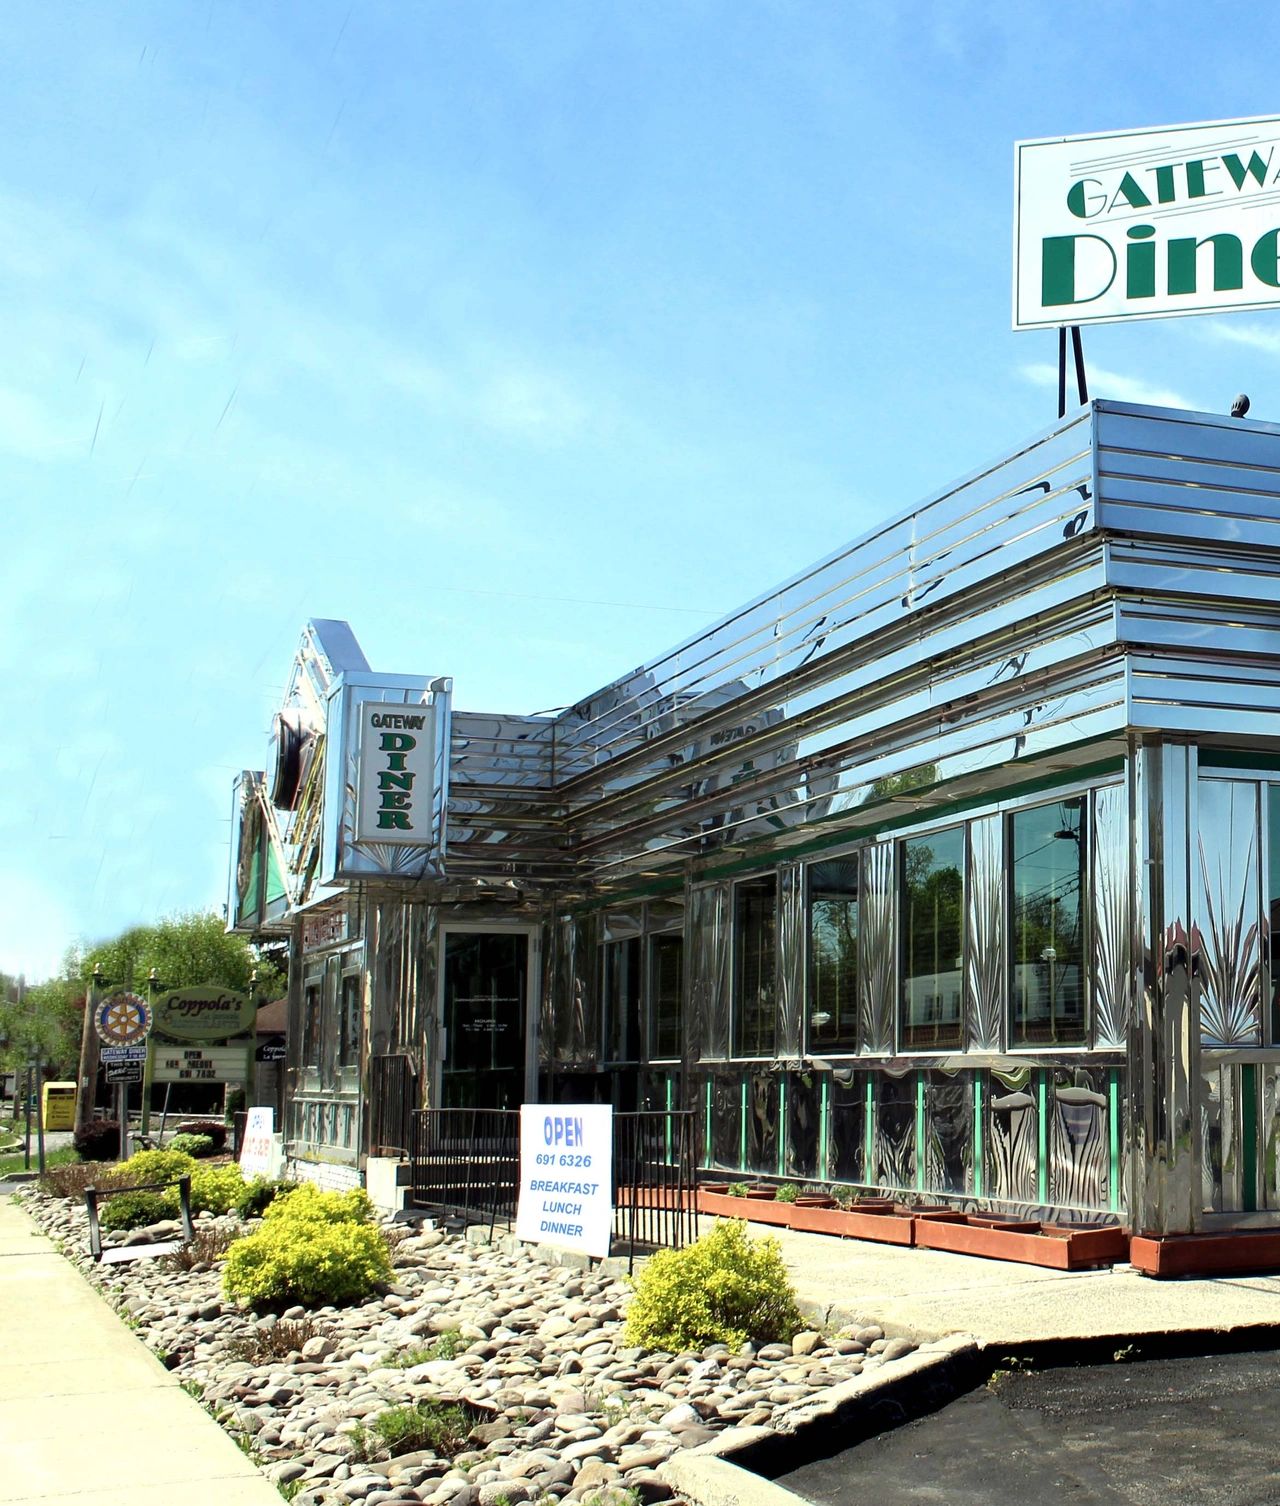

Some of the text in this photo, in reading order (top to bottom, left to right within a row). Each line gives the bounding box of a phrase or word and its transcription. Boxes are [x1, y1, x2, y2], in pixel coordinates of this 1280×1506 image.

[371, 713, 426, 730] GATEWAY
[376, 732, 417, 830] DINER
[168, 994, 242, 1017] Coppola's
[544, 1116, 583, 1147] OPEN
[536, 1154, 592, 1168] 691 6326
[530, 1180, 599, 1195] BREAKFAST
[542, 1201, 582, 1215] LUNCH
[540, 1221, 583, 1237] DINNER
